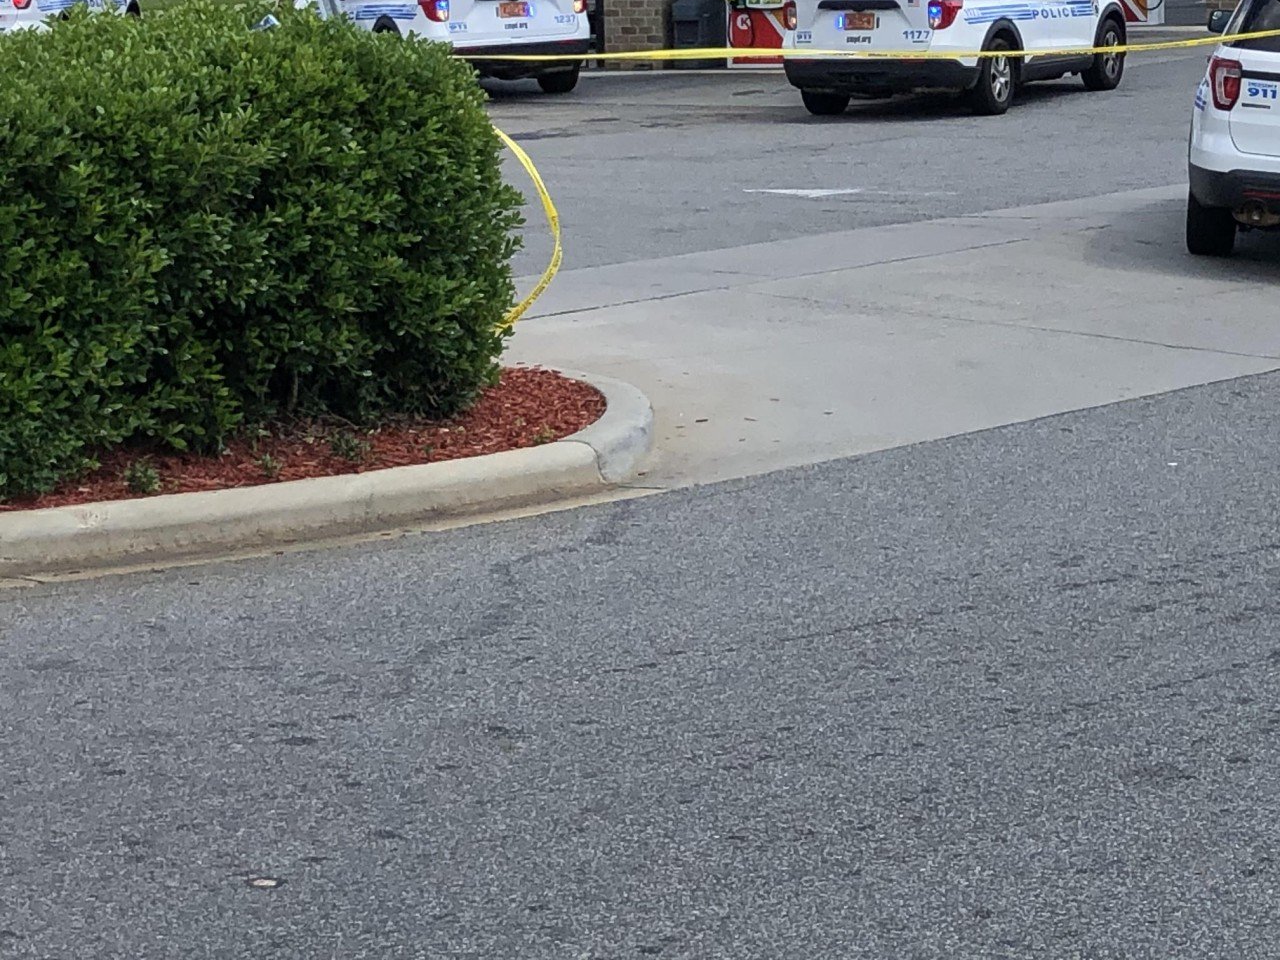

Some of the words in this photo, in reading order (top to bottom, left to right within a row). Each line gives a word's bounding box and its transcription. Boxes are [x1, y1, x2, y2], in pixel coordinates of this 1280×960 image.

[1032, 6, 1078, 19] POLICE
[554, 14, 576, 23] 1237
[738, 14, 750, 29] K
[902, 30, 930, 40] 1177
[1247, 88, 1277, 99] 911
